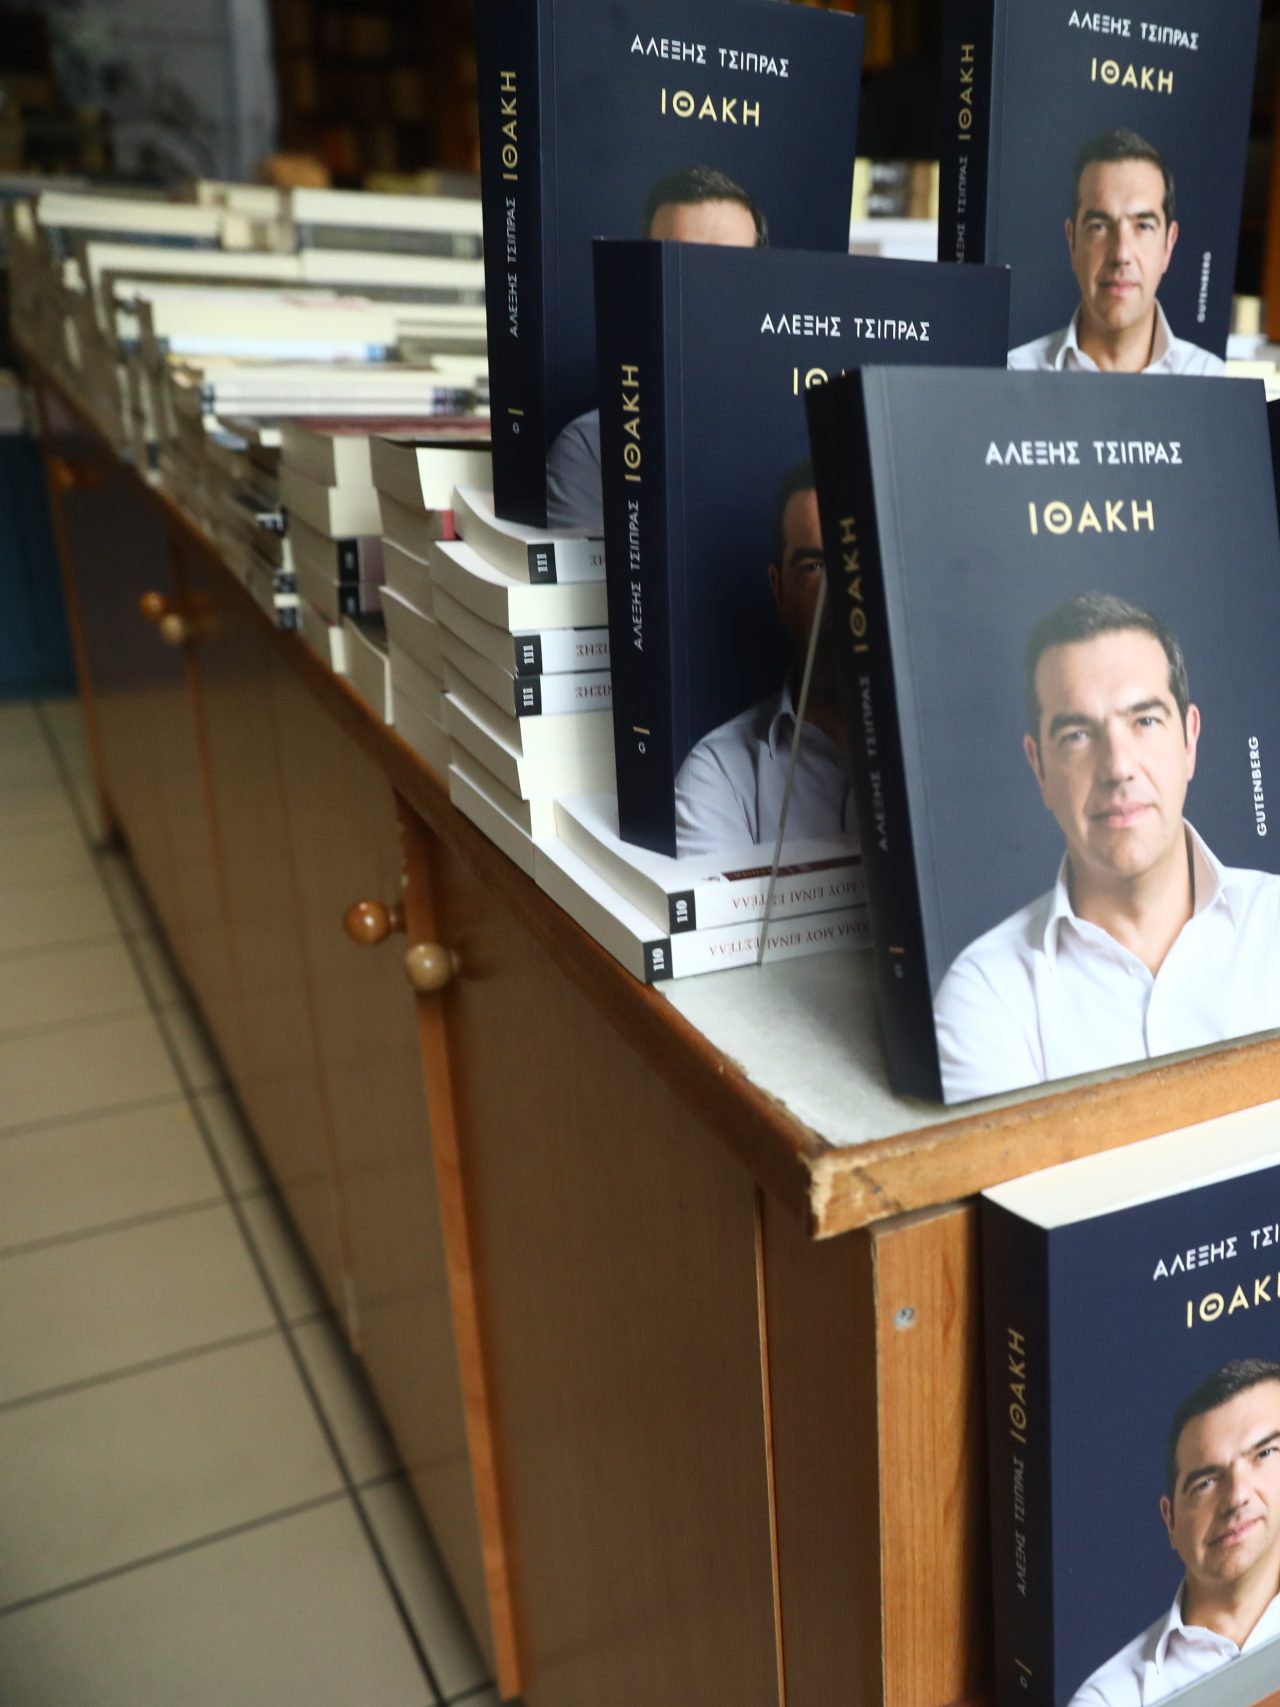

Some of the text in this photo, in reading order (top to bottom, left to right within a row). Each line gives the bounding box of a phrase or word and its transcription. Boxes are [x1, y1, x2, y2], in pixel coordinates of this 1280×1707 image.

[631, 34, 789, 77] ΑΛΕΞΗΣ ΤΣΙΠΡΑΣ
[1068, 10, 1199, 50] ΑΛΕΞΗΣ ΤΣΙΠΡΑΣ
[660, 88, 760, 127] ΙΘΑΚΗ
[957, 44, 975, 140] ΙΘΑΚΗ
[1091, 58, 1174, 95] ΙΘΑΚΗ
[500, 71, 518, 181] ΙΘΑΚΗ
[505, 197, 518, 338] ΑΛΕΞΗΣ ΤΣΙΠΡΑΣ
[1197, 251, 1212, 323] GUTENBERG
[761, 313, 930, 342] ΑΛΕΞΗΣ ΤΣΙΠΡΑΣ
[621, 364, 642, 482] ΙΘΑΚΗ
[985, 441, 1183, 465] ΑΛΕΞΗΣ ΤΣΙΠΡΑΣ
[1028, 500, 1155, 536] ΙΘΑΚΗ
[629, 500, 644, 651] ΑΛΕΞΗΣ ΤΣΙΠΡΑΣ
[840, 516, 869, 652] ΙΘΑΚΗ
[1248, 735, 1268, 838] GUTENBERG
[1153, 1236, 1238, 1281] ΑΛΕΞΗΣ
[1007, 1328, 1028, 1445] ΙΘΑΚΗ
[1012, 1456, 1027, 1597] ΑΛΕΞΗΣ ΤΣΙΠΡΑΣ
